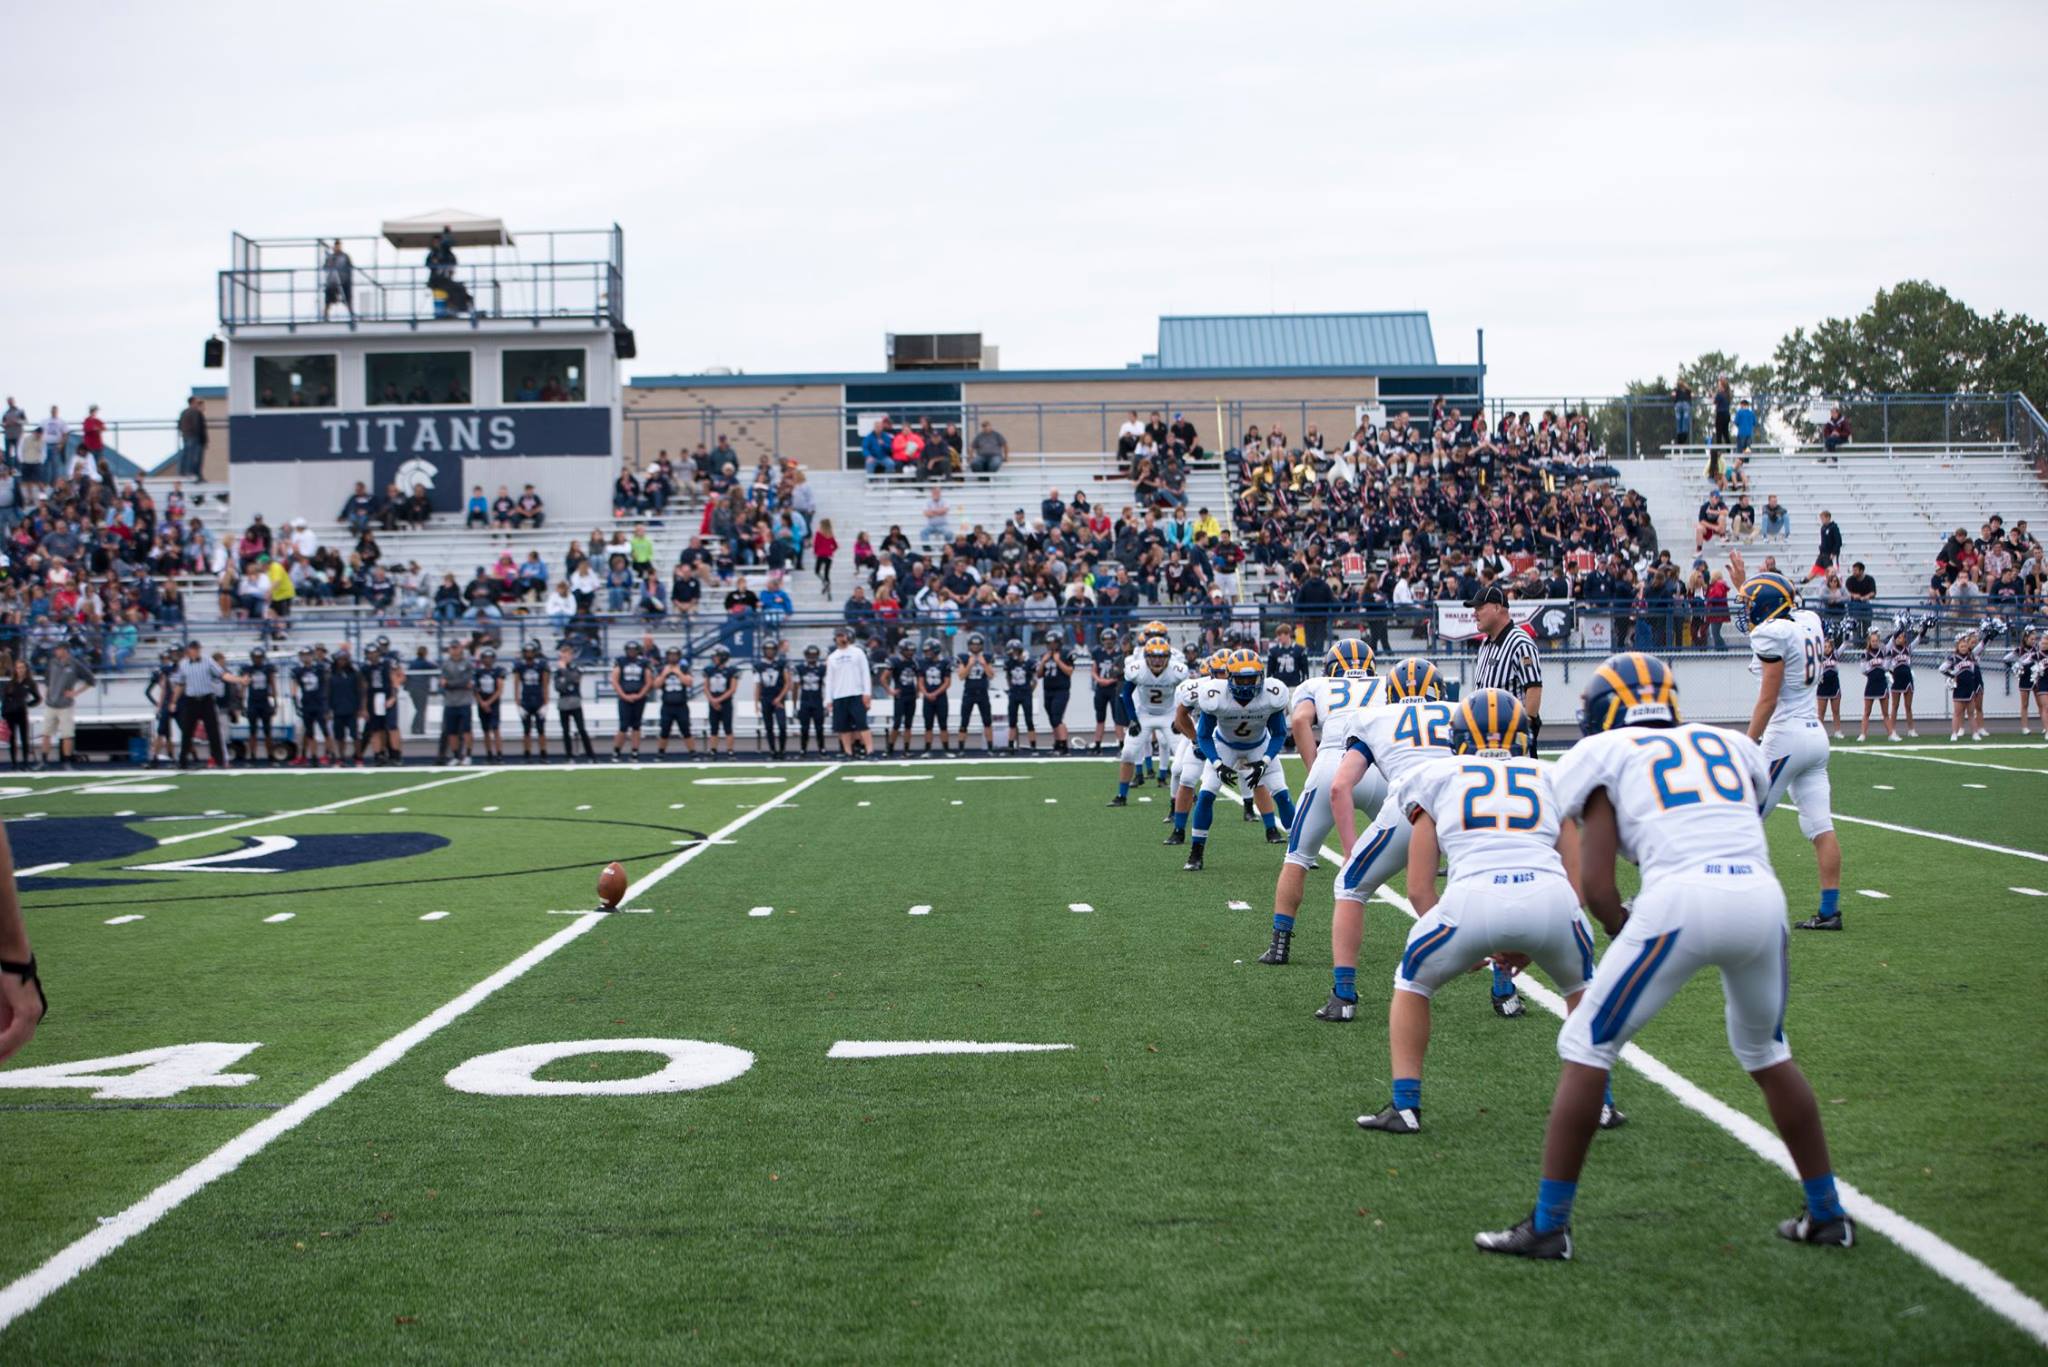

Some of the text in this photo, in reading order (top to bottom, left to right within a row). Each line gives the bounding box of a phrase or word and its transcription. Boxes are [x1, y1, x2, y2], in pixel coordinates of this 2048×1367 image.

[321, 416, 516, 454] TITANS
[733, 630, 745, 646] E
[1149, 688, 1163, 704] 2
[1187, 682, 1199, 701] 34
[1207, 688, 1221, 698] 6
[1328, 677, 1380, 714] 37
[1233, 720, 1252, 737] 6
[1393, 705, 1451, 748] 42
[1633, 730, 1746, 811] 28
[1459, 764, 1542, 832] 25
[1493, 871, 1535, 885] BIG MACS
[1704, 863, 1753, 875] BIG MACS
